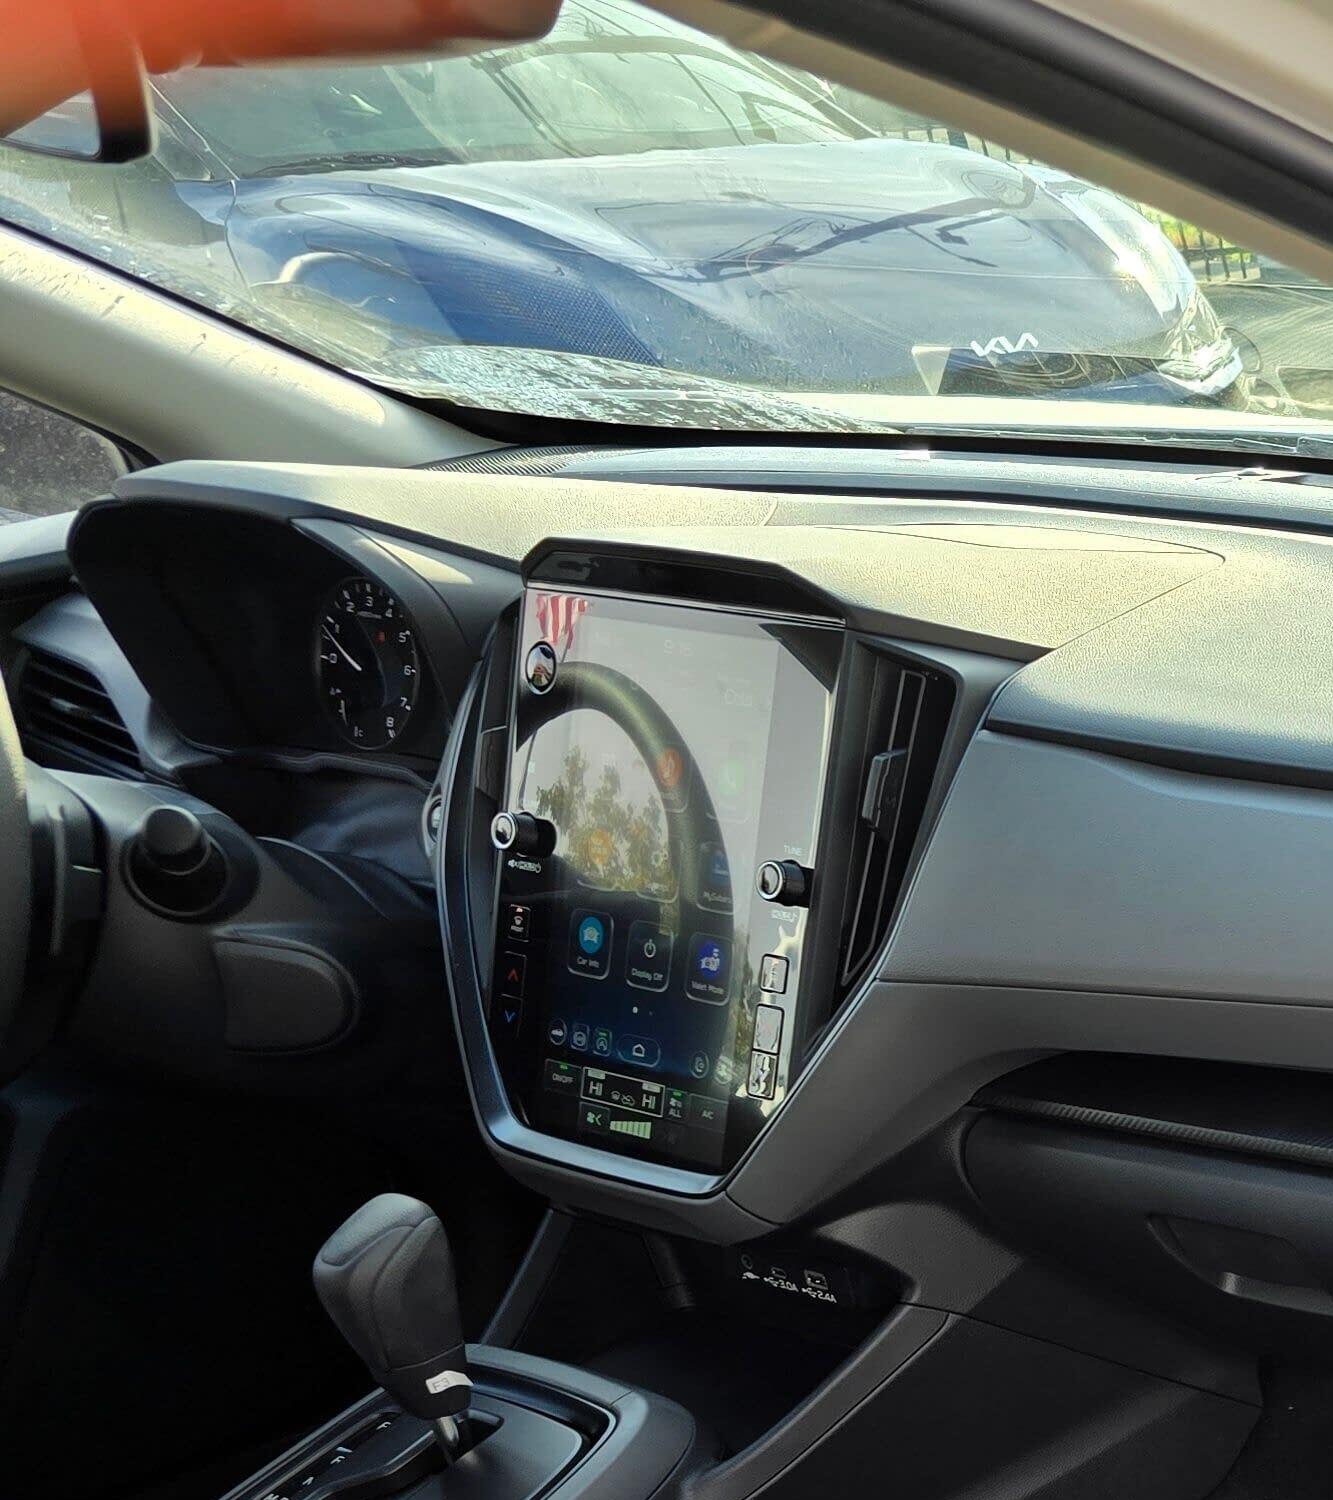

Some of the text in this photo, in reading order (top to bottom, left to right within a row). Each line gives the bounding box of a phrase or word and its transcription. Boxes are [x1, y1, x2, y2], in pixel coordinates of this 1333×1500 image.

[398, 632, 407, 643] 5
[404, 665, 412, 676] 6
[400, 697, 408, 708] 7
[385, 717, 395, 728] 8
[588, 1080, 603, 1096] HI
[641, 1094, 656, 1110] HI
